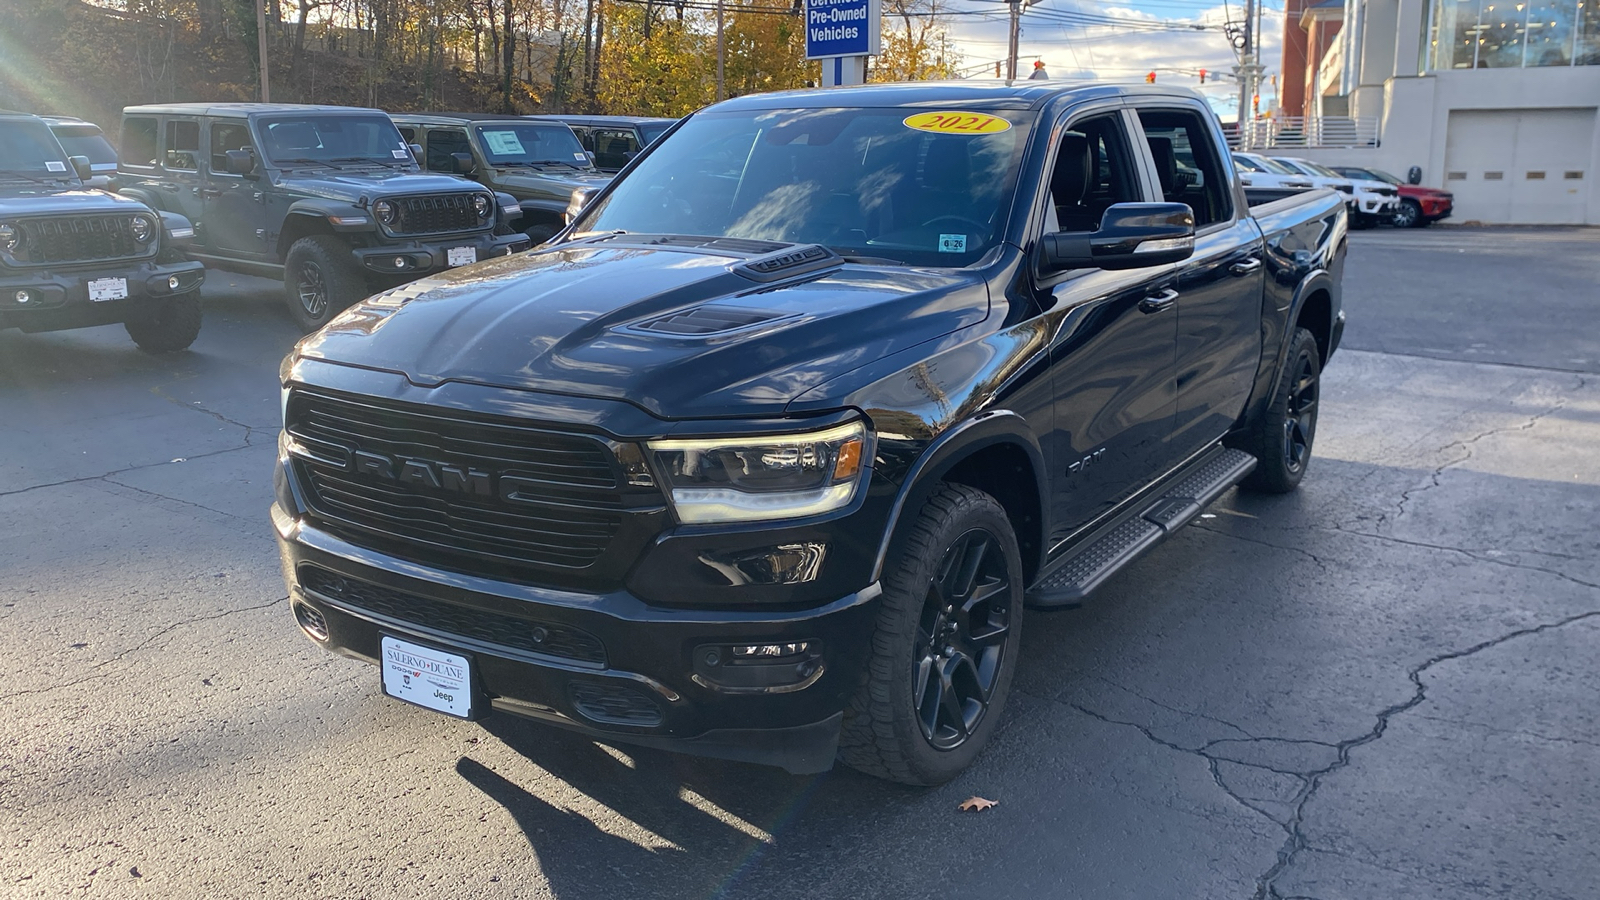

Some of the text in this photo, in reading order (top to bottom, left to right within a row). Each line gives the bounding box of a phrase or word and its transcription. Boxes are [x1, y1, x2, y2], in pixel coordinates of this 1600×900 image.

[810, 5, 867, 24] Pre-Owned
[810, 25, 859, 42] Vehicles
[919, 115, 996, 131] 2021
[953, 239, 964, 248] 26
[355, 450, 491, 495] RAM
[387, 650, 463, 679] SALERNO DUANE
[433, 689, 453, 702] Jeep
